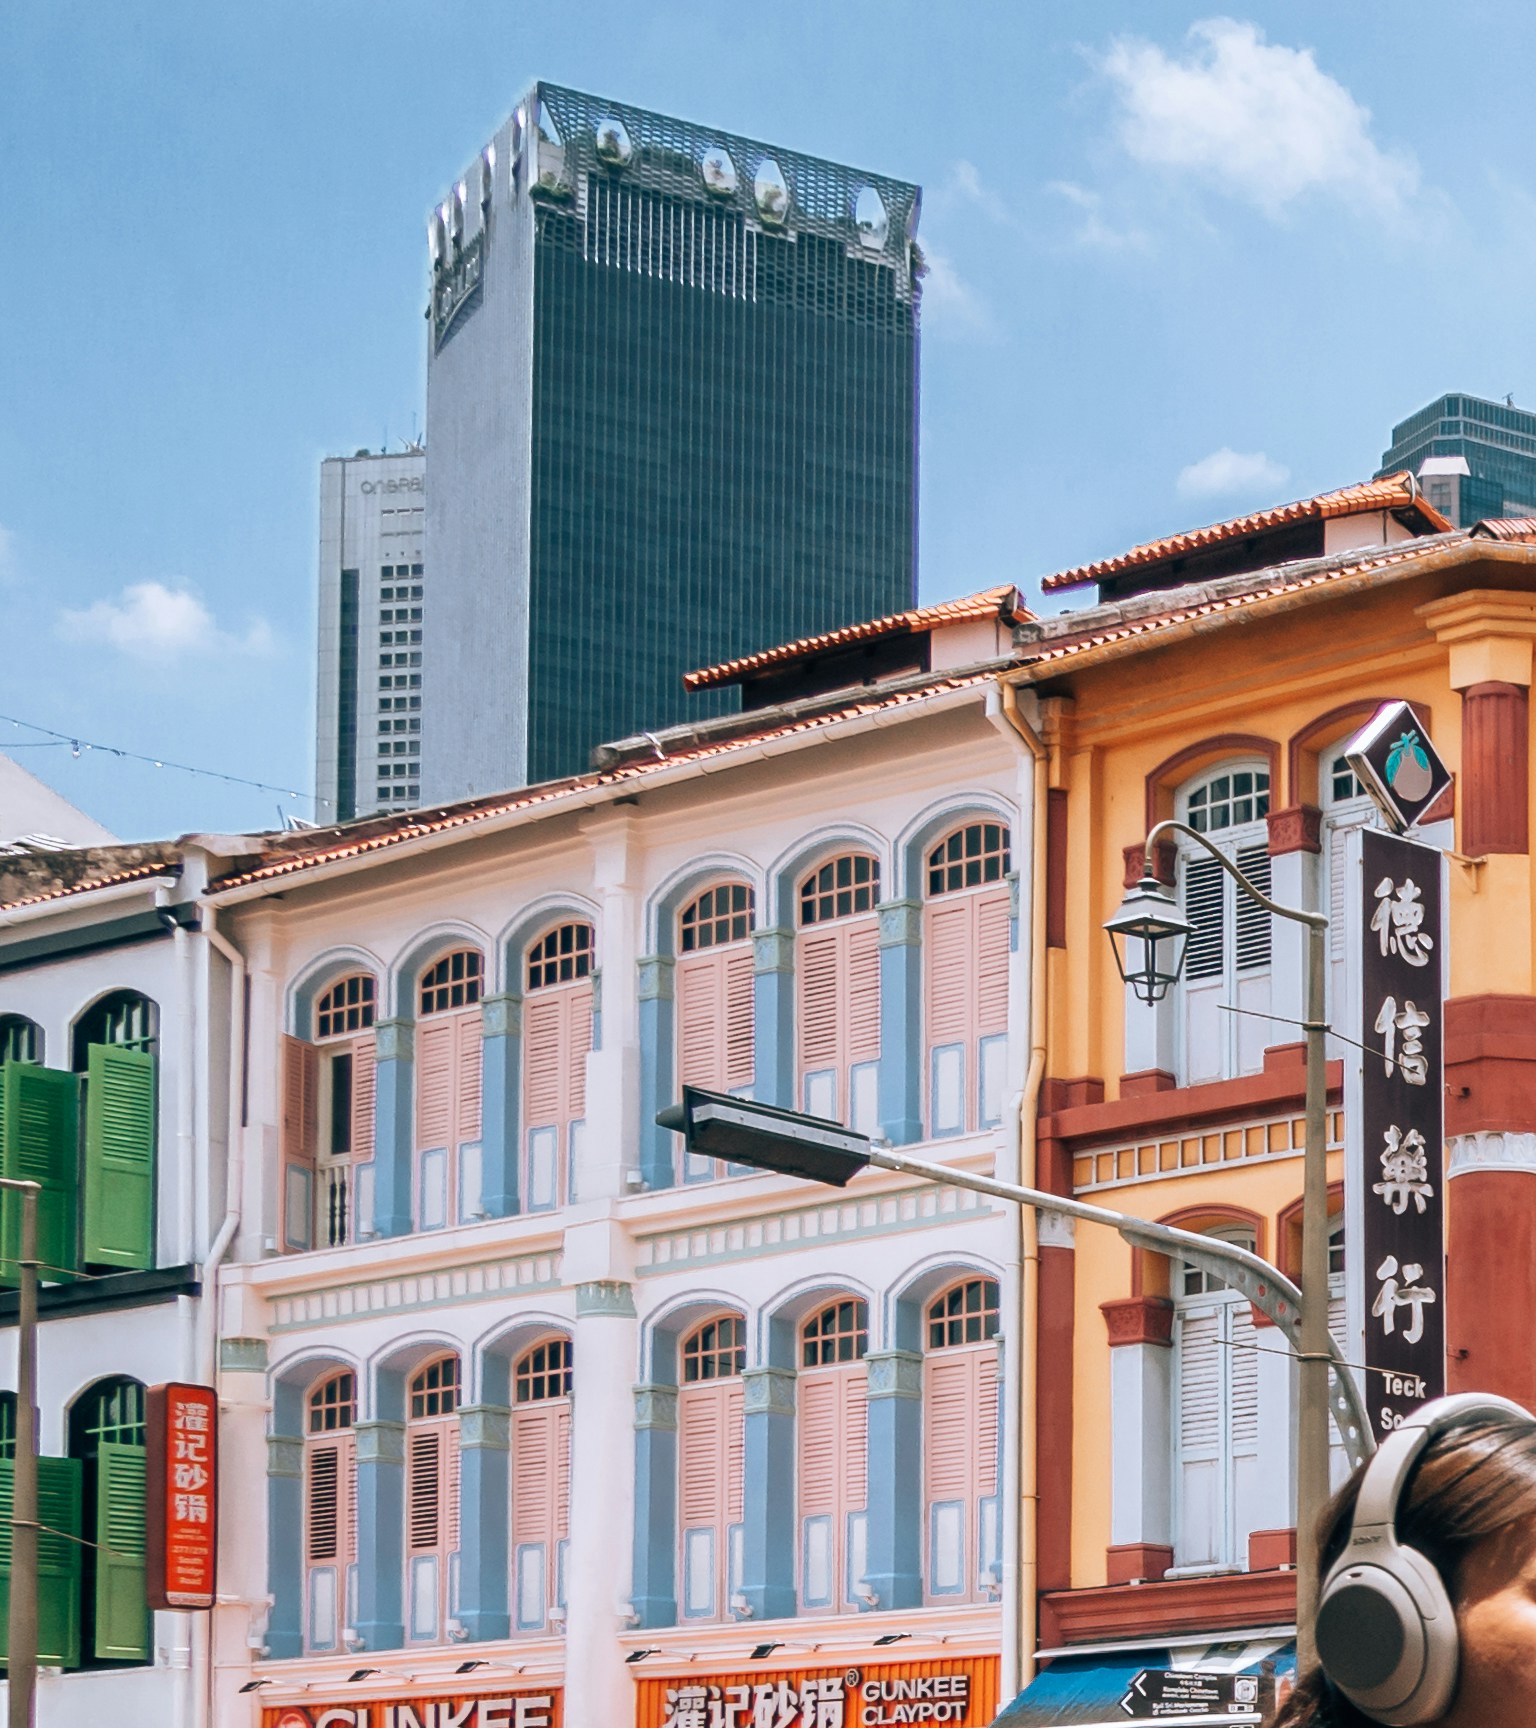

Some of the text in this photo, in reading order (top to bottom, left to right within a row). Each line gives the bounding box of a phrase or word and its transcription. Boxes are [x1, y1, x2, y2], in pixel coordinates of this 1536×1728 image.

[1381, 1371, 1427, 1400] Teck
[1380, 1406, 1406, 1432] So
[861, 1675, 969, 1701] GUNKEE
[860, 1702, 968, 1726] CLAYPOT
